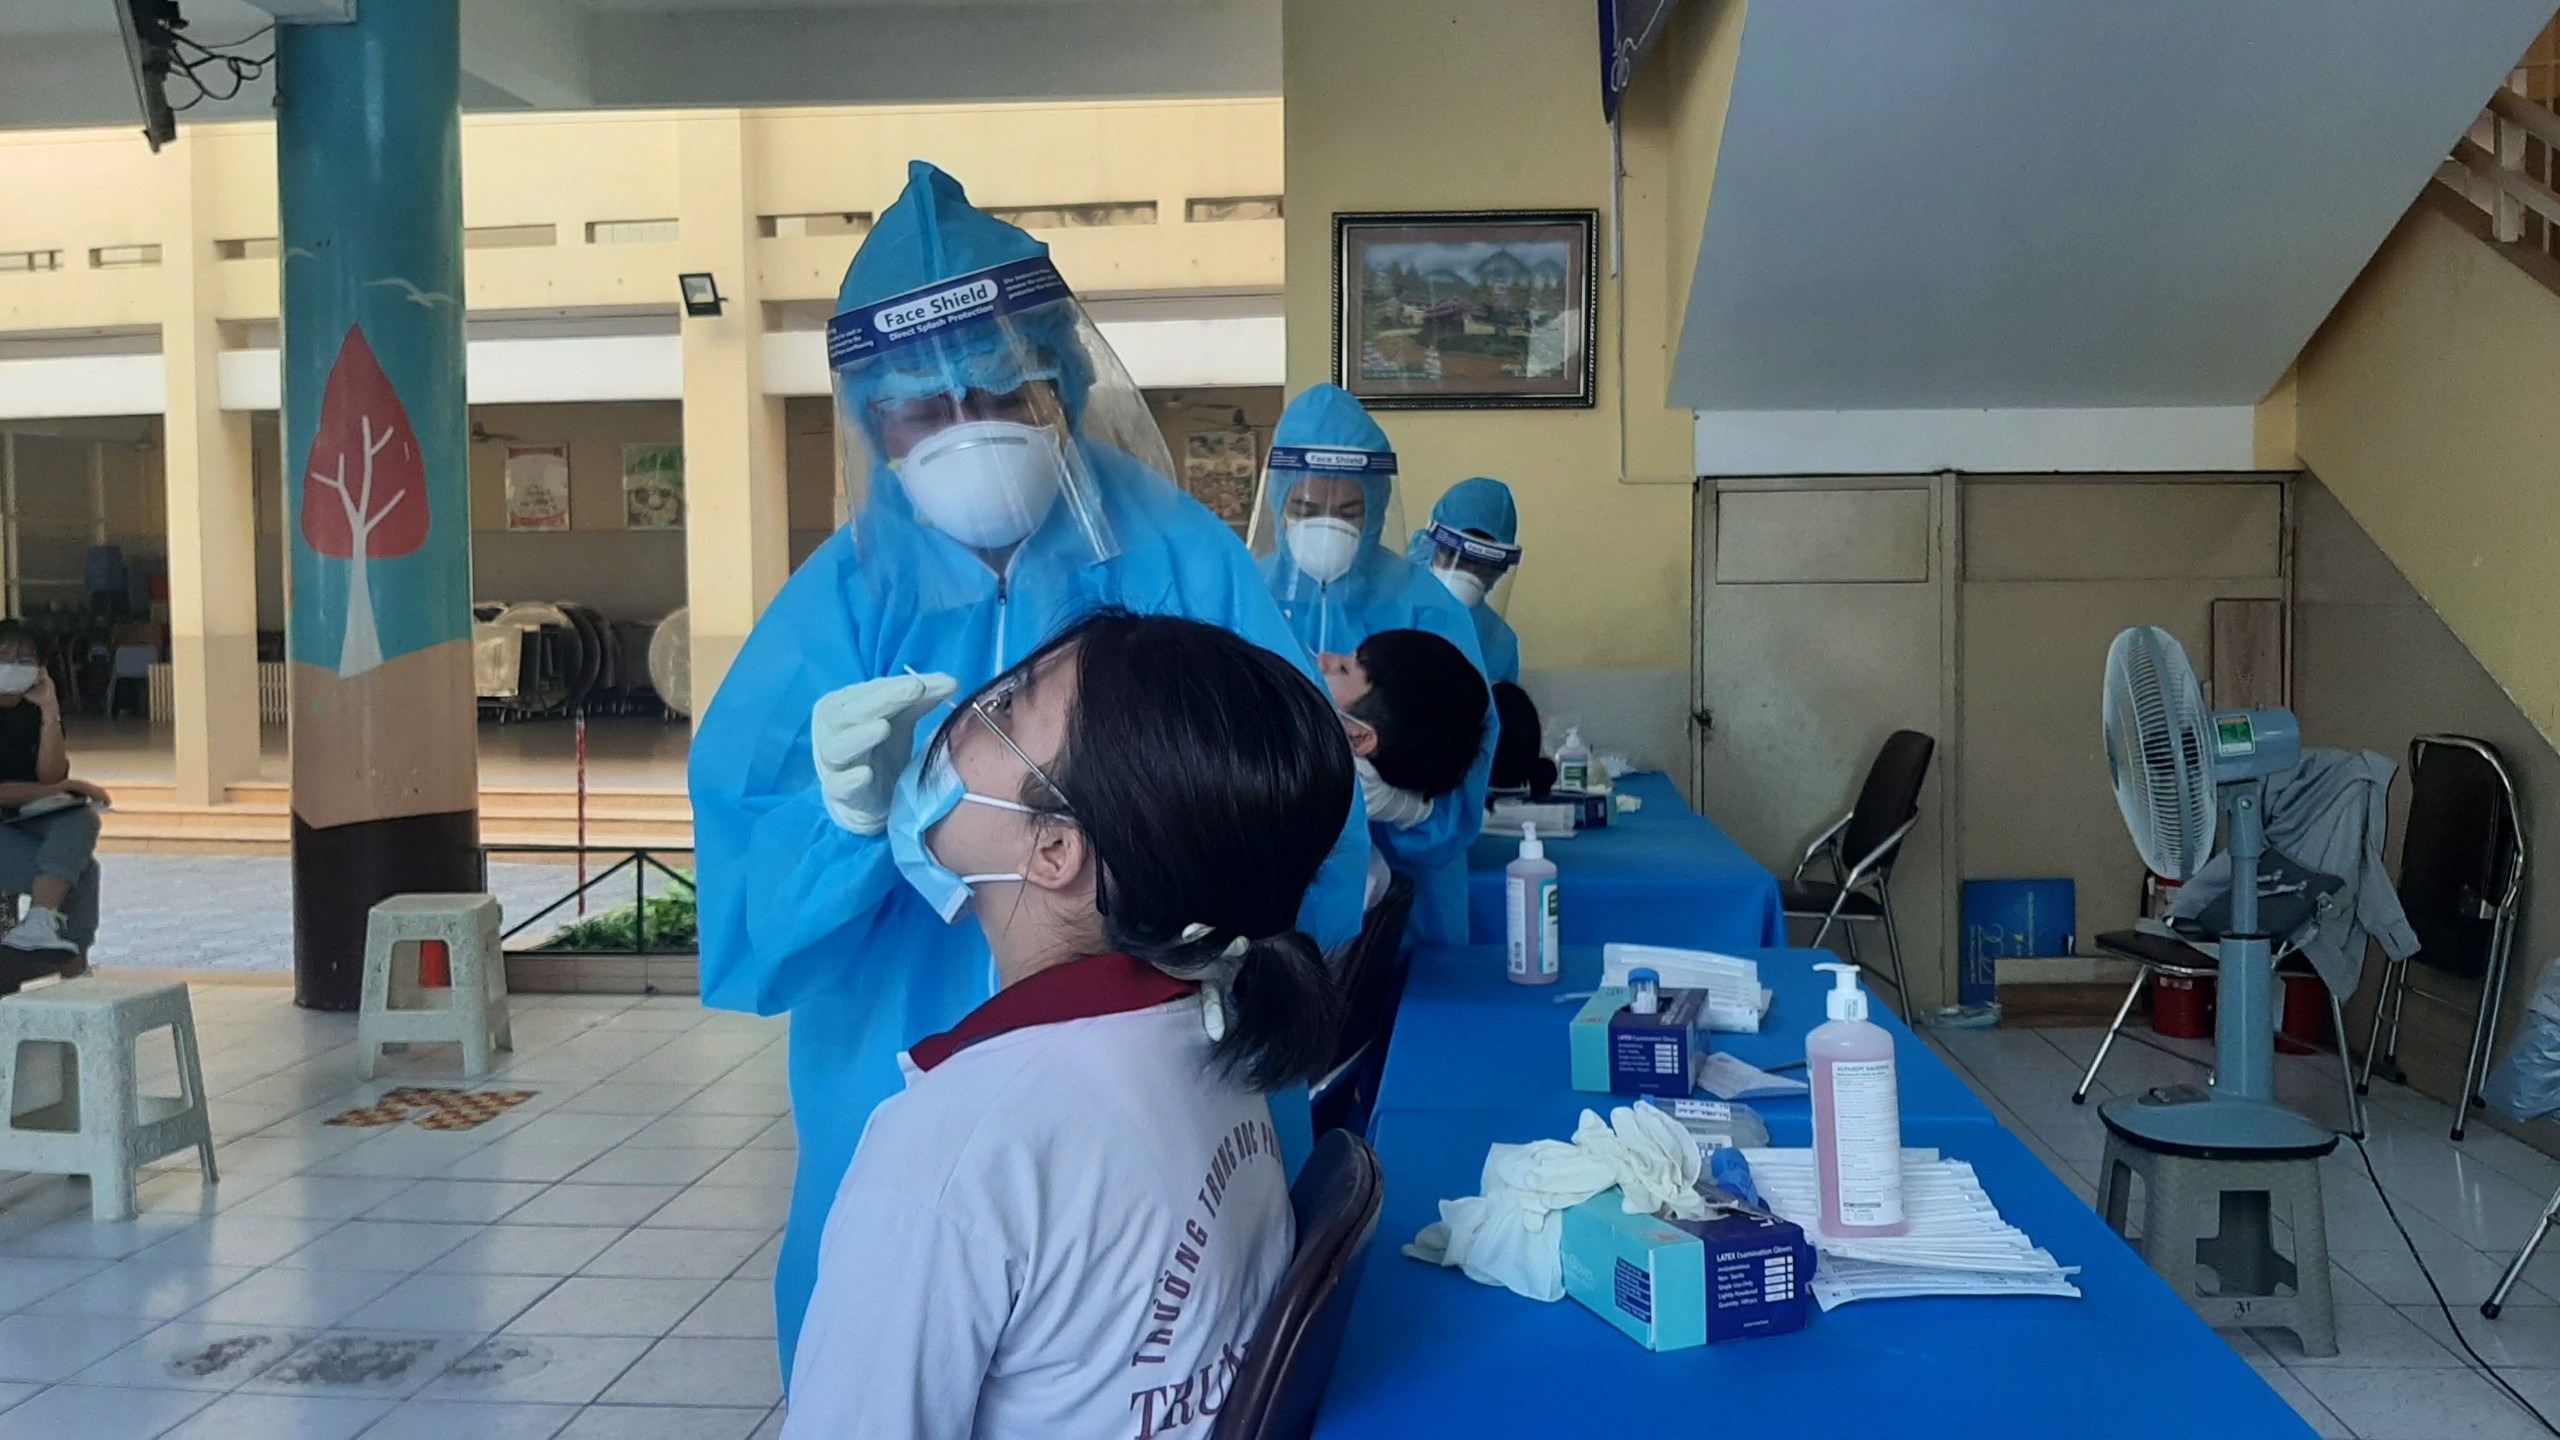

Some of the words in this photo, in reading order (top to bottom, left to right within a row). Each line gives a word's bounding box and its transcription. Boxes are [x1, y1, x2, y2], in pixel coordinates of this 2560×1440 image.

[884, 307, 926, 328] Face
[930, 284, 989, 314] Shield
[889, 327, 916, 342] Direct
[916, 317, 947, 334] Splash
[948, 304, 995, 324] Protection
[1310, 455, 1332, 464] Face
[1335, 456, 1363, 465] Shield
[1131, 1218, 1209, 1368] TRƯỜNG
[1199, 1135, 1237, 1220] TRUNG
[1232, 1119, 1259, 1165] HỌC
[1716, 1252, 1736, 1262] LATEX
